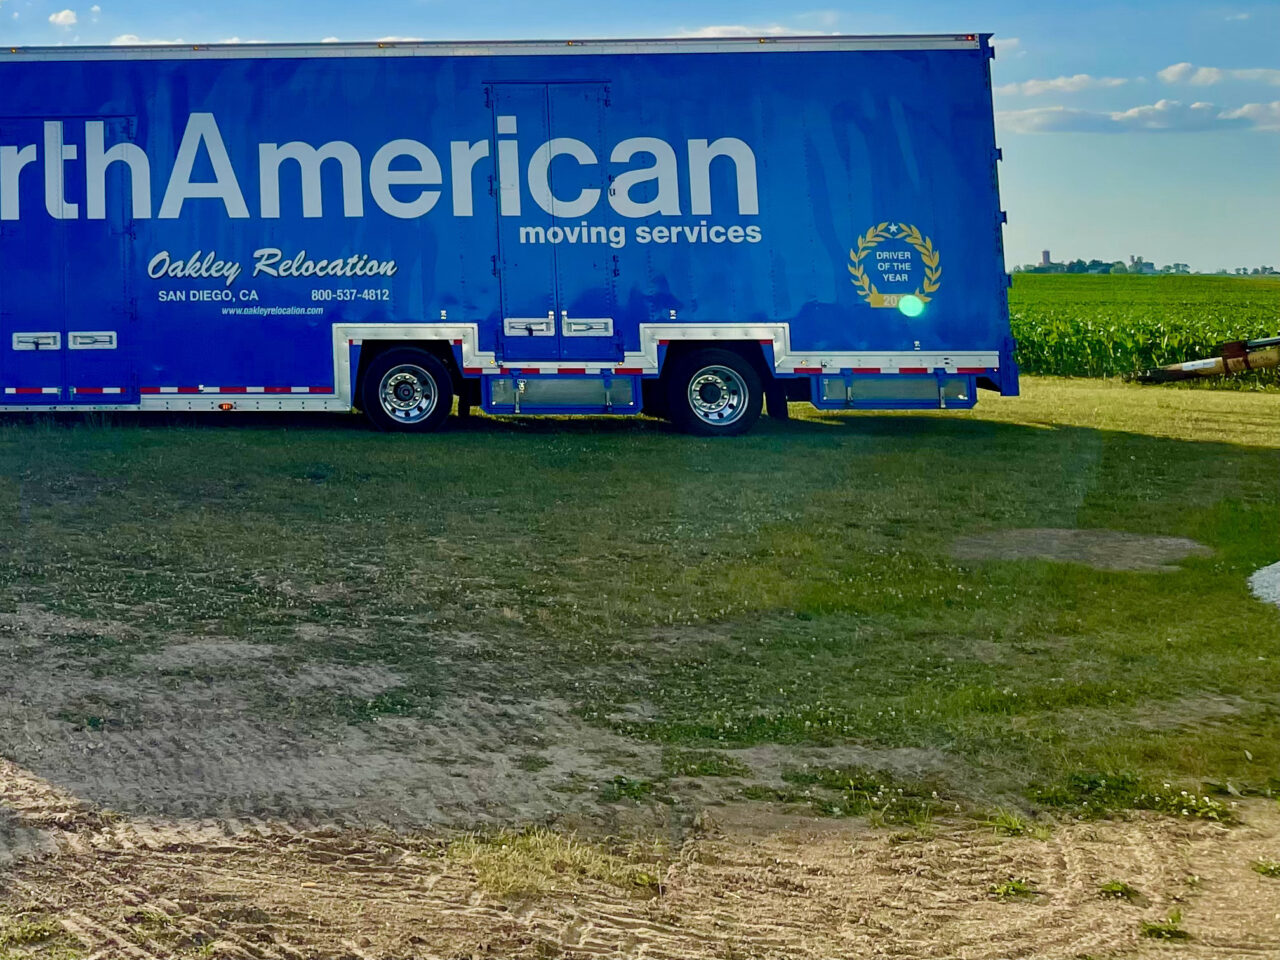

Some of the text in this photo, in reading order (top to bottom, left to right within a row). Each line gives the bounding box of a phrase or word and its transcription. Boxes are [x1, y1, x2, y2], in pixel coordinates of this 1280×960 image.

[519, 220, 762, 248] moving services
[876, 251, 911, 260] DRIVER
[147, 248, 398, 286] Oakley Relocation
[877, 263, 911, 271] OF THE
[883, 273, 908, 282] YEAR
[158, 290, 259, 303] SAN DIEGO, CA
[311, 289, 390, 301] 800-537-4812
[221, 306, 324, 317] www.oakleyrelocation.com
